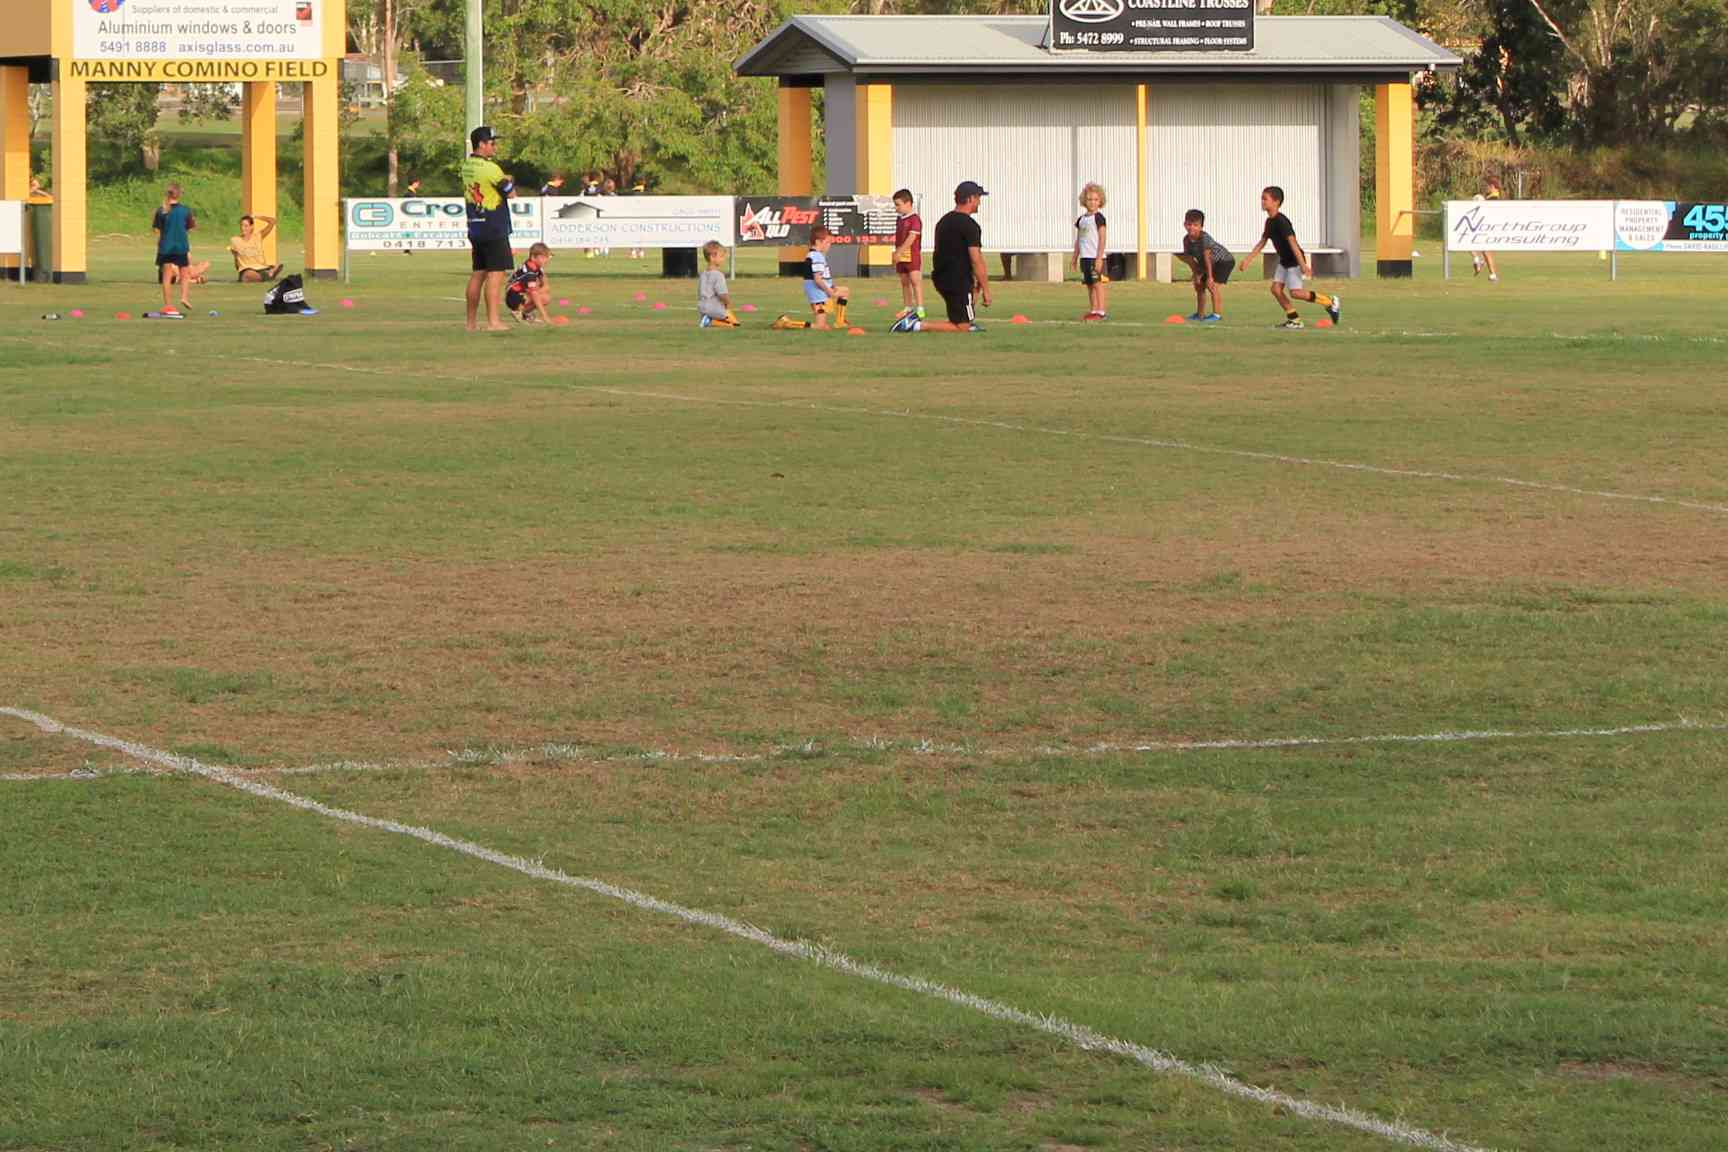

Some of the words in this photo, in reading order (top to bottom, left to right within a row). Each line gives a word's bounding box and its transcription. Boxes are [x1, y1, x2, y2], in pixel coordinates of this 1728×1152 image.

[131, 4, 171, 15] Suppliers
[173, 4, 181, 14] of
[183, 4, 220, 14] domestic
[223, 4, 229, 14] &
[231, 4, 279, 14] commercial
[98, 21, 172, 35] Aluminium
[177, 21, 238, 35] windows
[243, 21, 252, 35] &
[256, 21, 297, 35] doors
[1060, 32, 1074, 45] Ph:
[1077, 32, 1099, 45] 5472
[1101, 32, 1124, 45] 8999
[100, 41, 131, 53] 5491
[135, 41, 167, 53] 8888
[178, 40, 295, 56] axisglass.com.au
[70, 61, 160, 77] MANNY
[163, 61, 258, 77] COMINO
[265, 61, 328, 77] FIELD
[1454, 214, 1588, 234] NorthGroup
[1683, 204, 1728, 232] 45
[551, 223, 617, 233] ADDERSON
[622, 223, 720, 233] CONSTRUCTIONS
[766, 224, 791, 238] QLD
[1472, 234, 1581, 246] Consulting
[1689, 232, 1723, 241] property
[383, 240, 425, 248] 0418
[436, 240, 466, 248] 713
